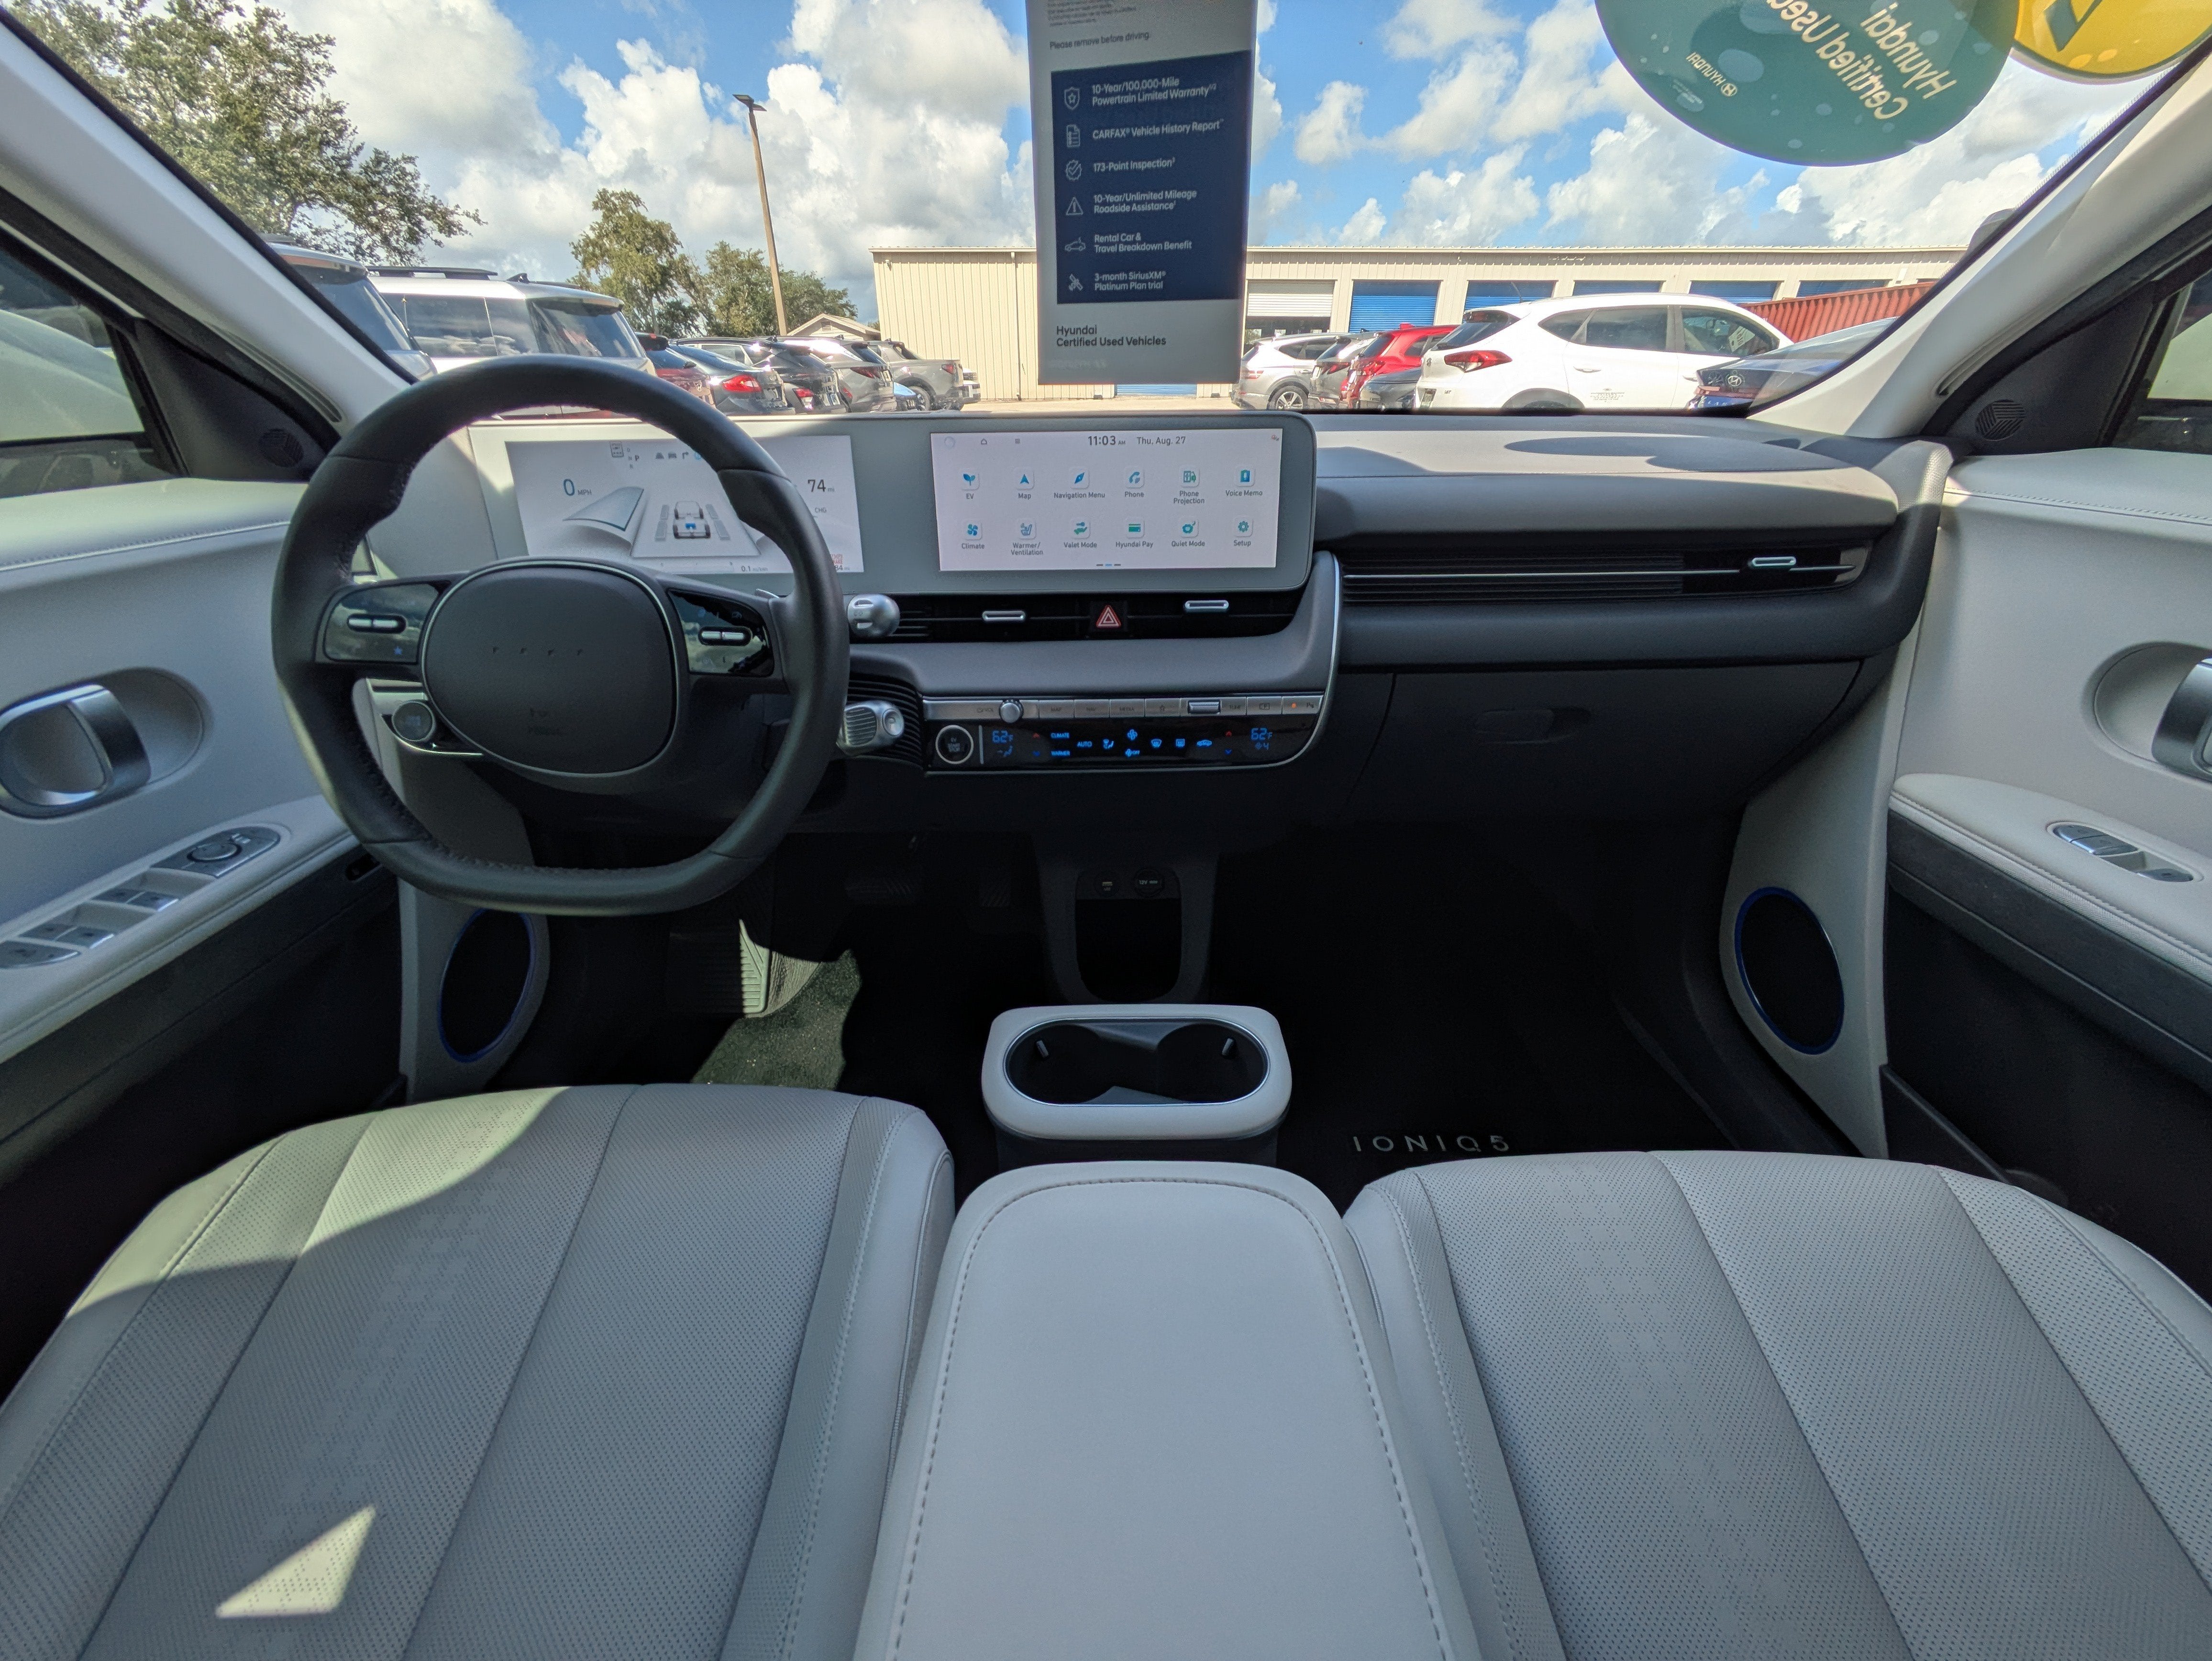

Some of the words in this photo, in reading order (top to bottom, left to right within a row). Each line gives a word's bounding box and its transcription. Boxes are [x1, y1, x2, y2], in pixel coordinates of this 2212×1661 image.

[1101, 34, 1124, 44] before
[1092, 77, 1180, 94] 10-Year/100,000-Mile
[1092, 94, 1136, 106] Powertrain
[1138, 90, 1168, 102] Limited
[1131, 125, 1160, 137] Vehicle
[1161, 123, 1191, 134] History
[1094, 161, 1129, 172] 173-Point
[1094, 191, 1163, 203] 10-Year/Unlimited
[1165, 189, 1197, 201] Mileage
[1094, 204, 1130, 213] Roadside
[1095, 233, 1119, 243] Rental
[1120, 233, 1134, 242] Car
[1135, 233, 1141, 241] &
[1094, 244, 1117, 253] Travel
[1118, 242, 1163, 252] Breakdown
[1164, 240, 1193, 250] Benefit
[1095, 272, 1127, 281] 3-month
[1094, 282, 1128, 291] Platinum
[1129, 281, 1147, 290] Plan
[1148, 281, 1163, 289] trial
[1056, 324, 1097, 337] Hyundai
[1056, 337, 1097, 347] Certified
[1099, 336, 1124, 346] Used
[1125, 335, 1167, 346] Vehicles
[1087, 435, 1116, 445] 11:03
[1137, 436, 1154, 445] Thu,
[1155, 436, 1172, 446] Aug.
[1175, 436, 1186, 444] 27
[563, 478, 575, 496] 0
[807, 479, 826, 492] 74
